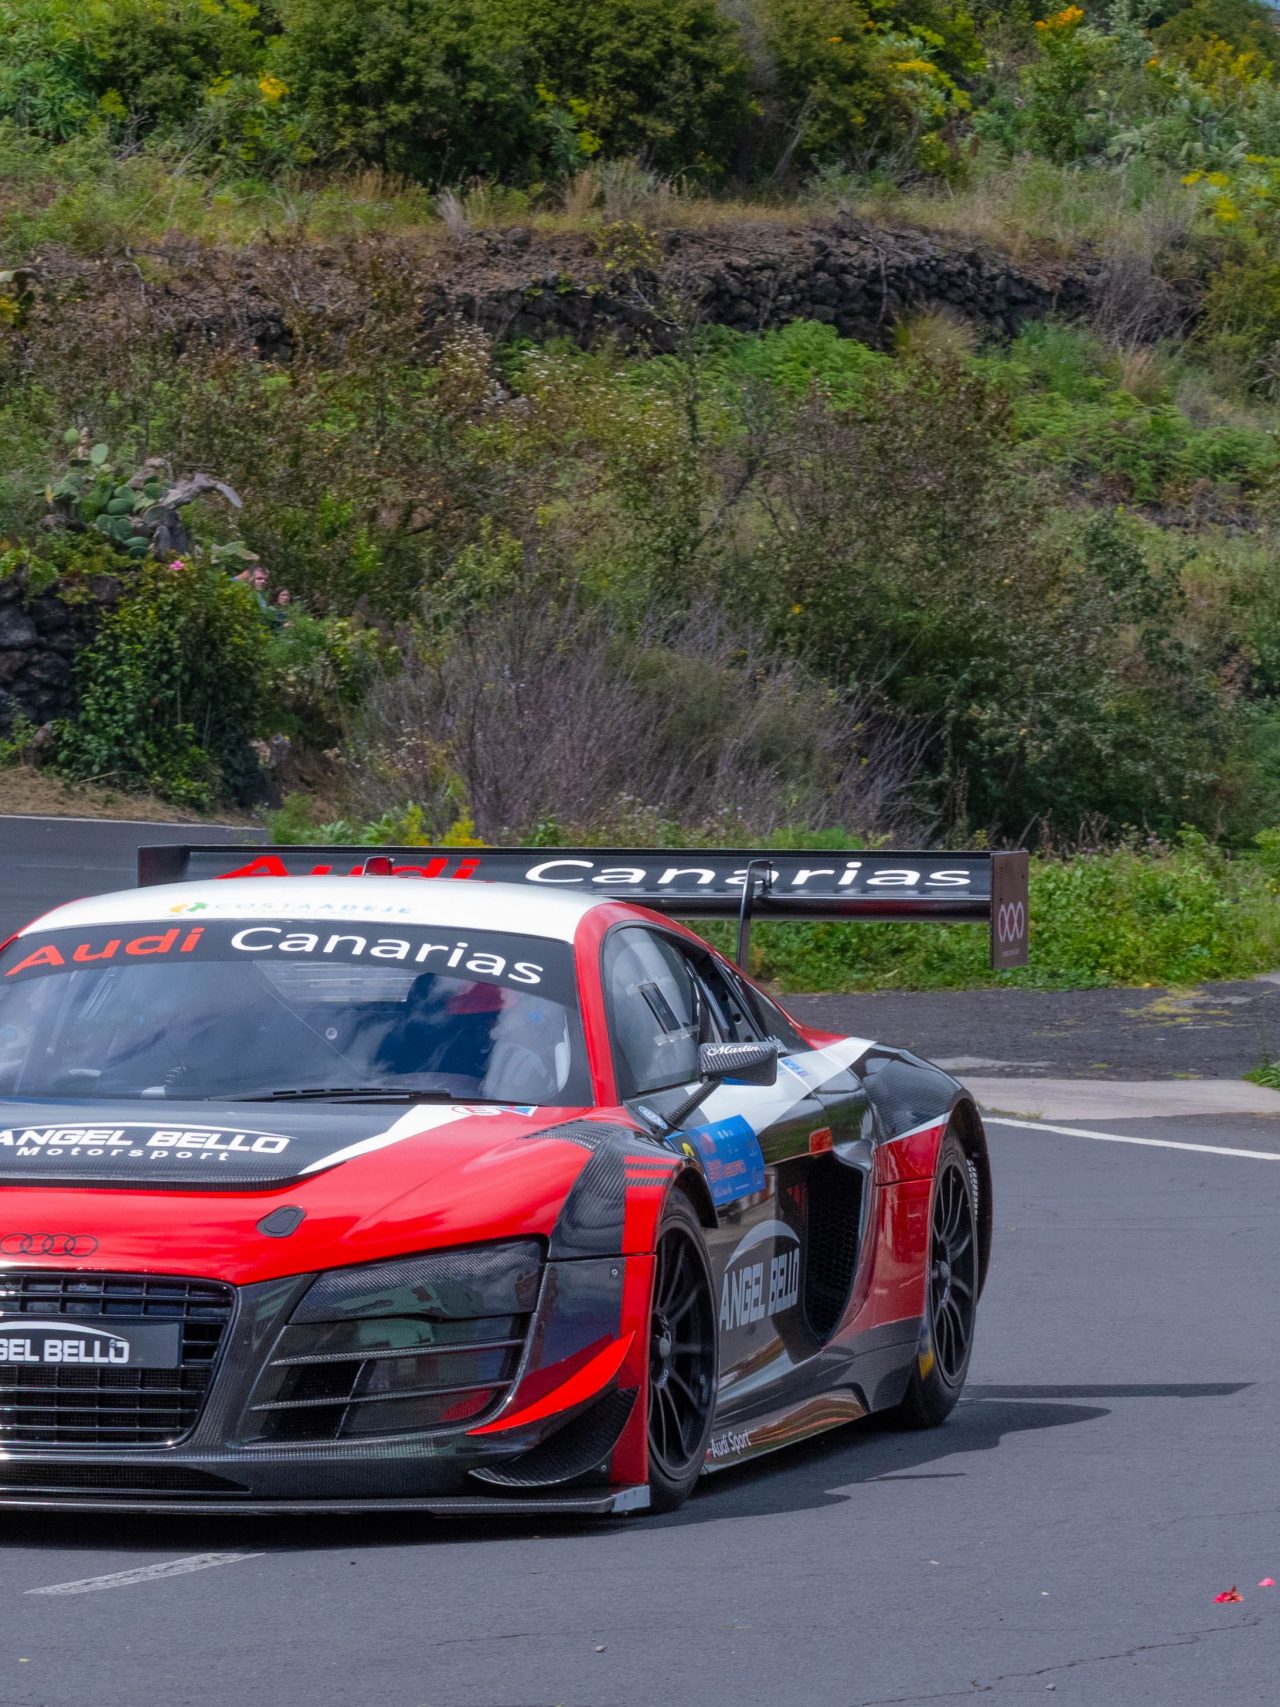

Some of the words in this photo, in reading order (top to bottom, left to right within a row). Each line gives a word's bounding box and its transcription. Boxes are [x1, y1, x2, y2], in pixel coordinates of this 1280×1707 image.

[525, 859, 971, 886] Canarias
[4, 927, 205, 976] Audi
[230, 926, 544, 984] Canarias
[16, 1146, 230, 1161] Motorsport
[146, 1131, 290, 1153] BELLO
[720, 1262, 765, 1332] ANGEL
[768, 1248, 800, 1316] BELLO
[44, 1339, 130, 1364] BELLO
[711, 1433, 730, 1458] Audi
[728, 1429, 752, 1455] Sport
